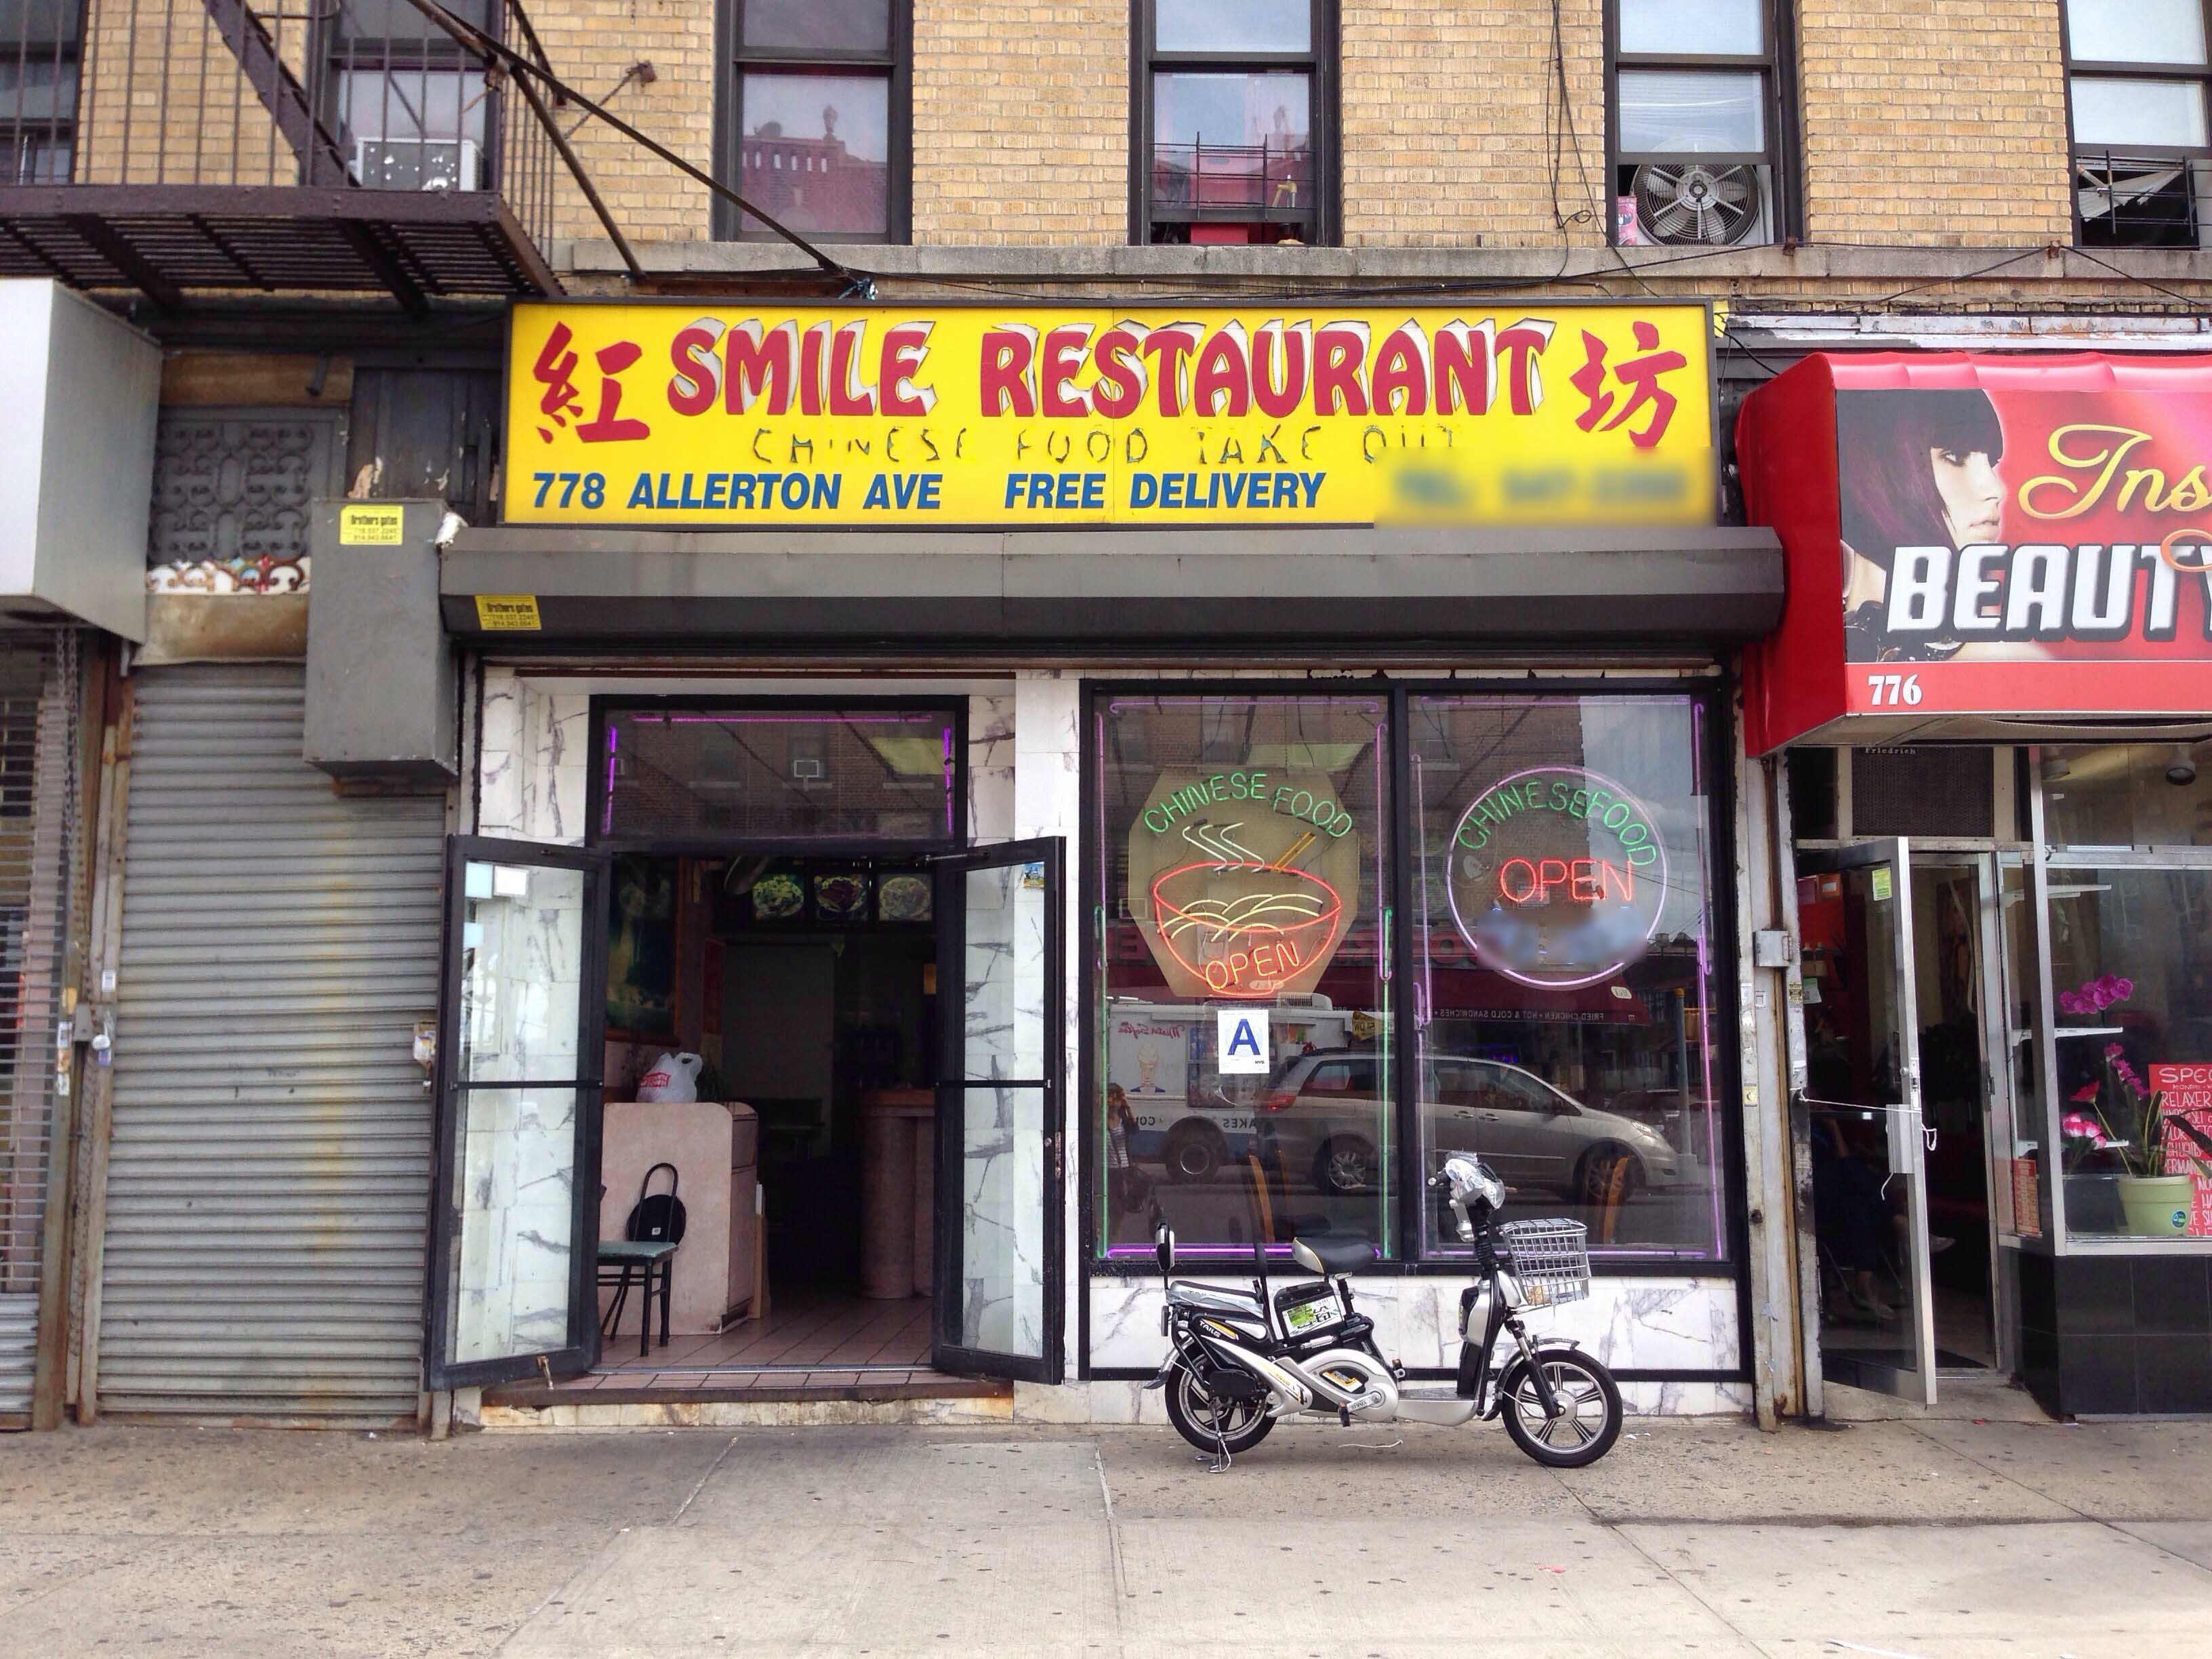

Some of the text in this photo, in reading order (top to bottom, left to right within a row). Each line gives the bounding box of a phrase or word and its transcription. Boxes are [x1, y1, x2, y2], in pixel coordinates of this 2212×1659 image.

[667, 316, 1557, 418] SMILE RESTAURANT
[1569, 321, 1687, 449] 坊
[1017, 426, 1149, 465] FOOD
[1191, 424, 1321, 465] TAKE
[533, 471, 1327, 510] 778 ALLERTON AVE FREE DELIVERY
[1866, 674, 1923, 706] 776
[1143, 772, 1353, 838] CHINESE FOOD
[1456, 781, 1658, 867] CHINESE FOOD
[1500, 857, 1635, 903] OPEN
[1205, 940, 1300, 990] OPEN
[1227, 1019, 1261, 1056] A
[2160, 1090, 2212, 1107] RELAXER
